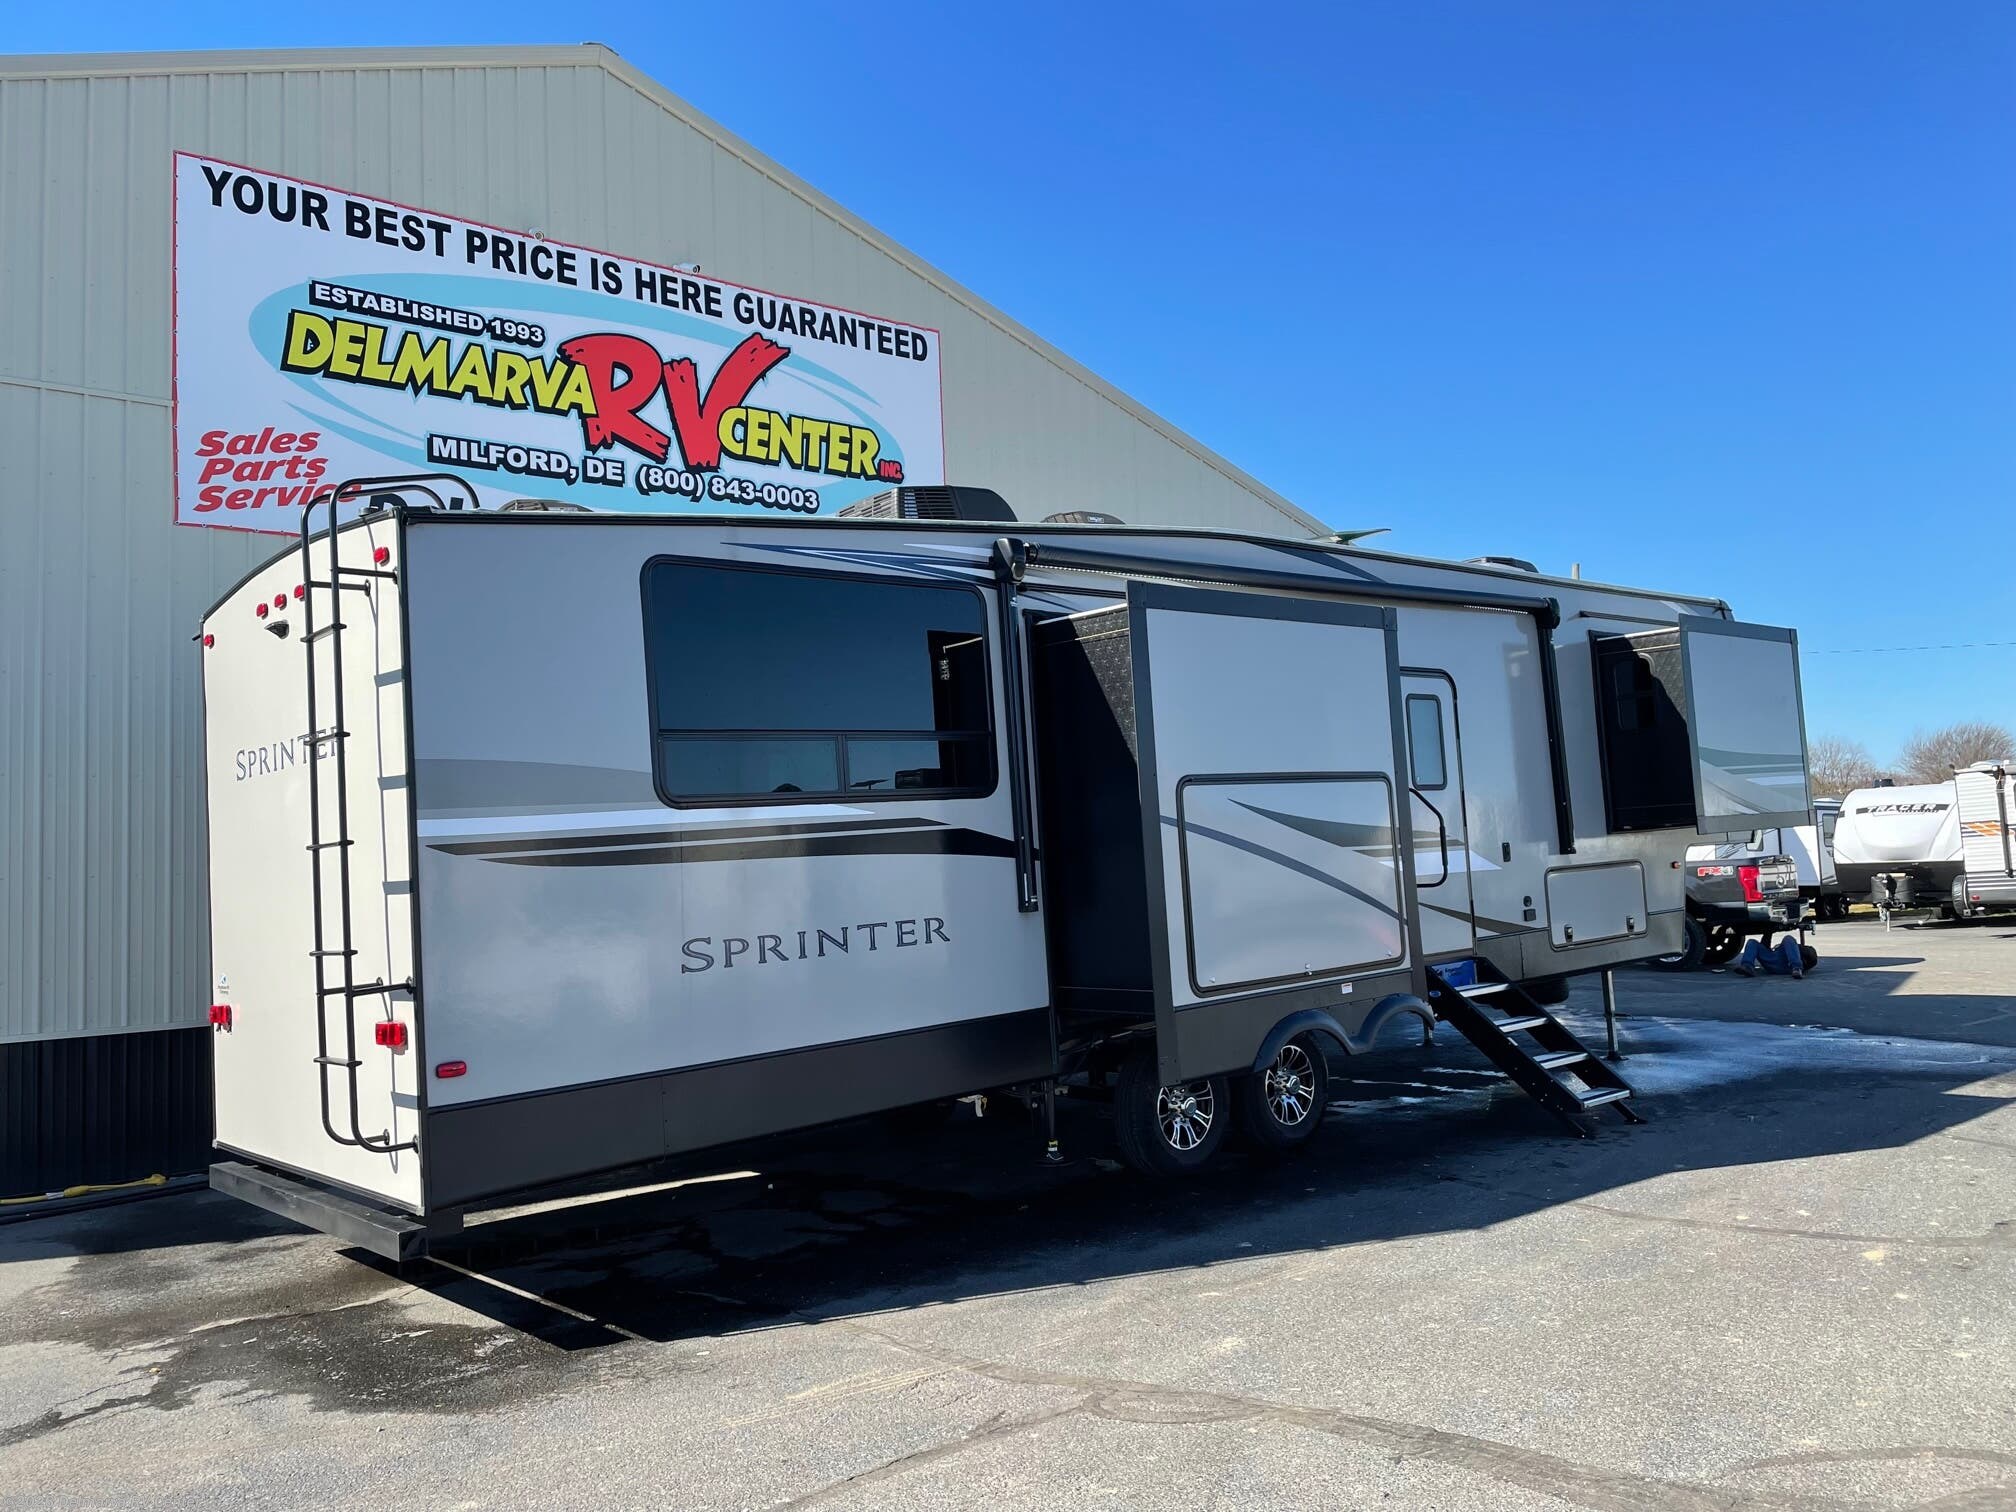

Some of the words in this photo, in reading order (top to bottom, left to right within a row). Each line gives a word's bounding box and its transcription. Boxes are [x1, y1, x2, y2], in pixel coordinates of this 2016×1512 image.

[201, 166, 330, 231] YOUR
[345, 200, 451, 257] BEST
[466, 229, 577, 285] PRICE
[591, 258, 622, 294] IS
[635, 268, 723, 317] HERE
[733, 292, 928, 361] GUARANTEED
[315, 284, 484, 331] ESTABLISHED
[491, 320, 544, 343] 1993
[286, 312, 598, 415] DELMARVA
[558, 332, 790, 470] RV
[195, 427, 321, 456] Sales
[198, 453, 328, 484] Parts
[432, 437, 577, 479] MILFORD,
[587, 458, 623, 481] DE
[640, 464, 704, 498] (800)
[711, 477, 818, 510] 843-0003
[719, 405, 880, 477] CENTER
